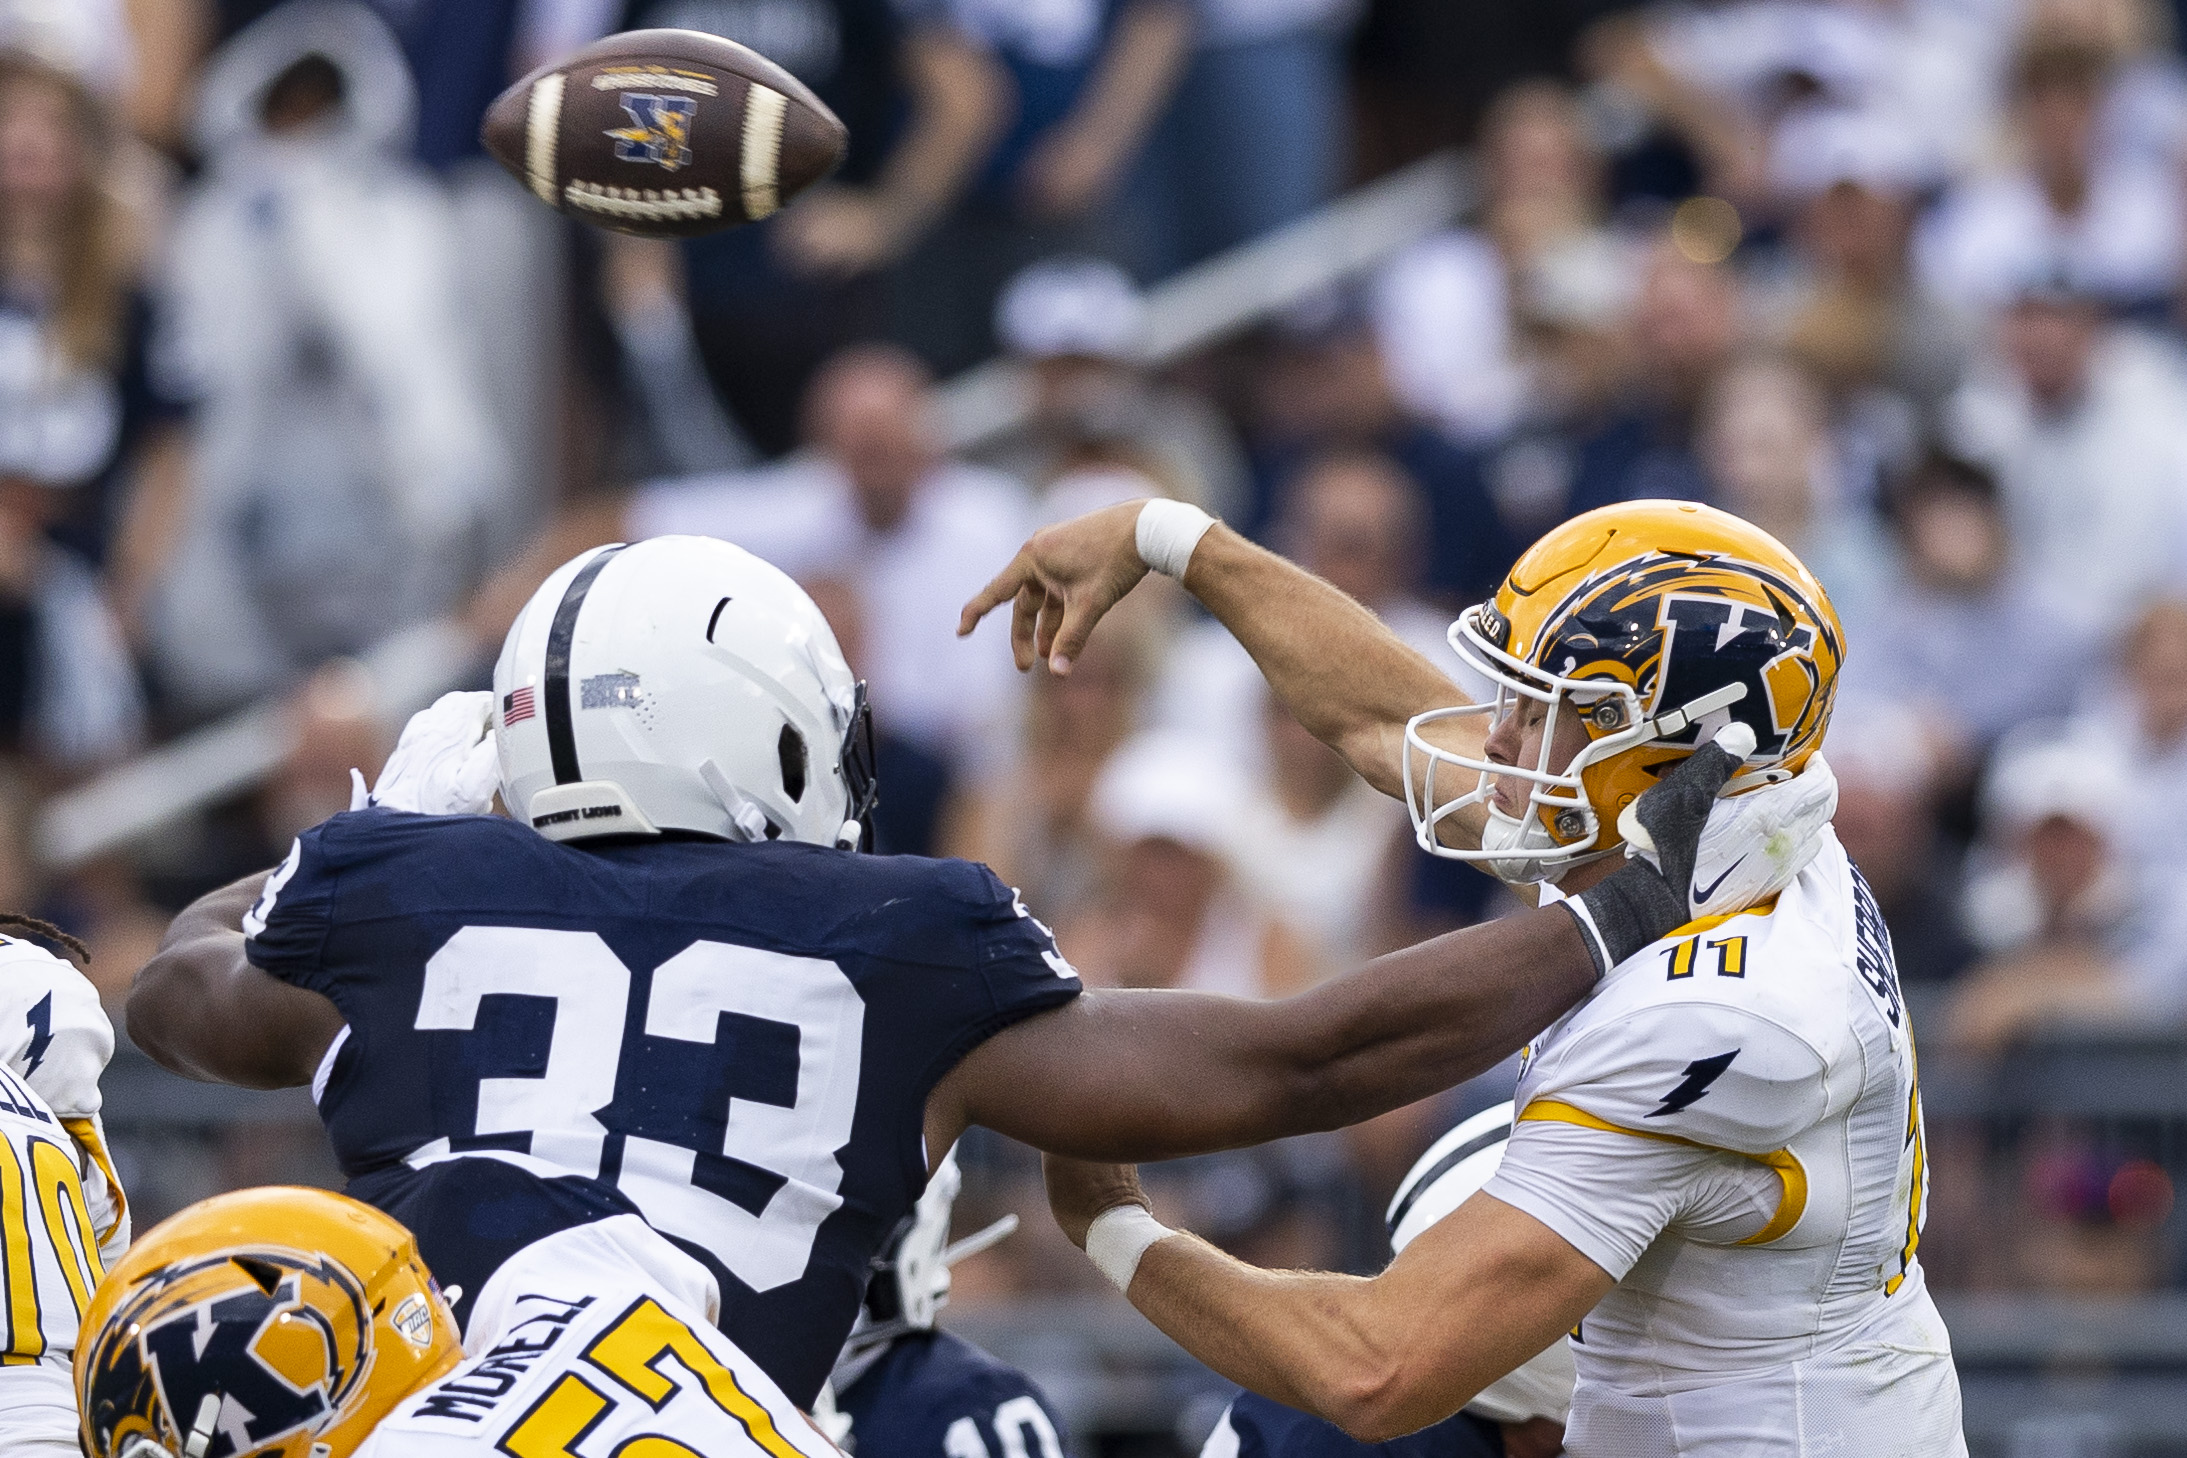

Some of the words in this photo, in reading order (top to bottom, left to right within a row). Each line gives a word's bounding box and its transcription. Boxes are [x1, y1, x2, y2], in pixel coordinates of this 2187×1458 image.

[1642, 592, 1818, 760] K
[1659, 934, 1748, 981] 11
[414, 925, 867, 1293] 33
[139, 1269, 334, 1458] K
